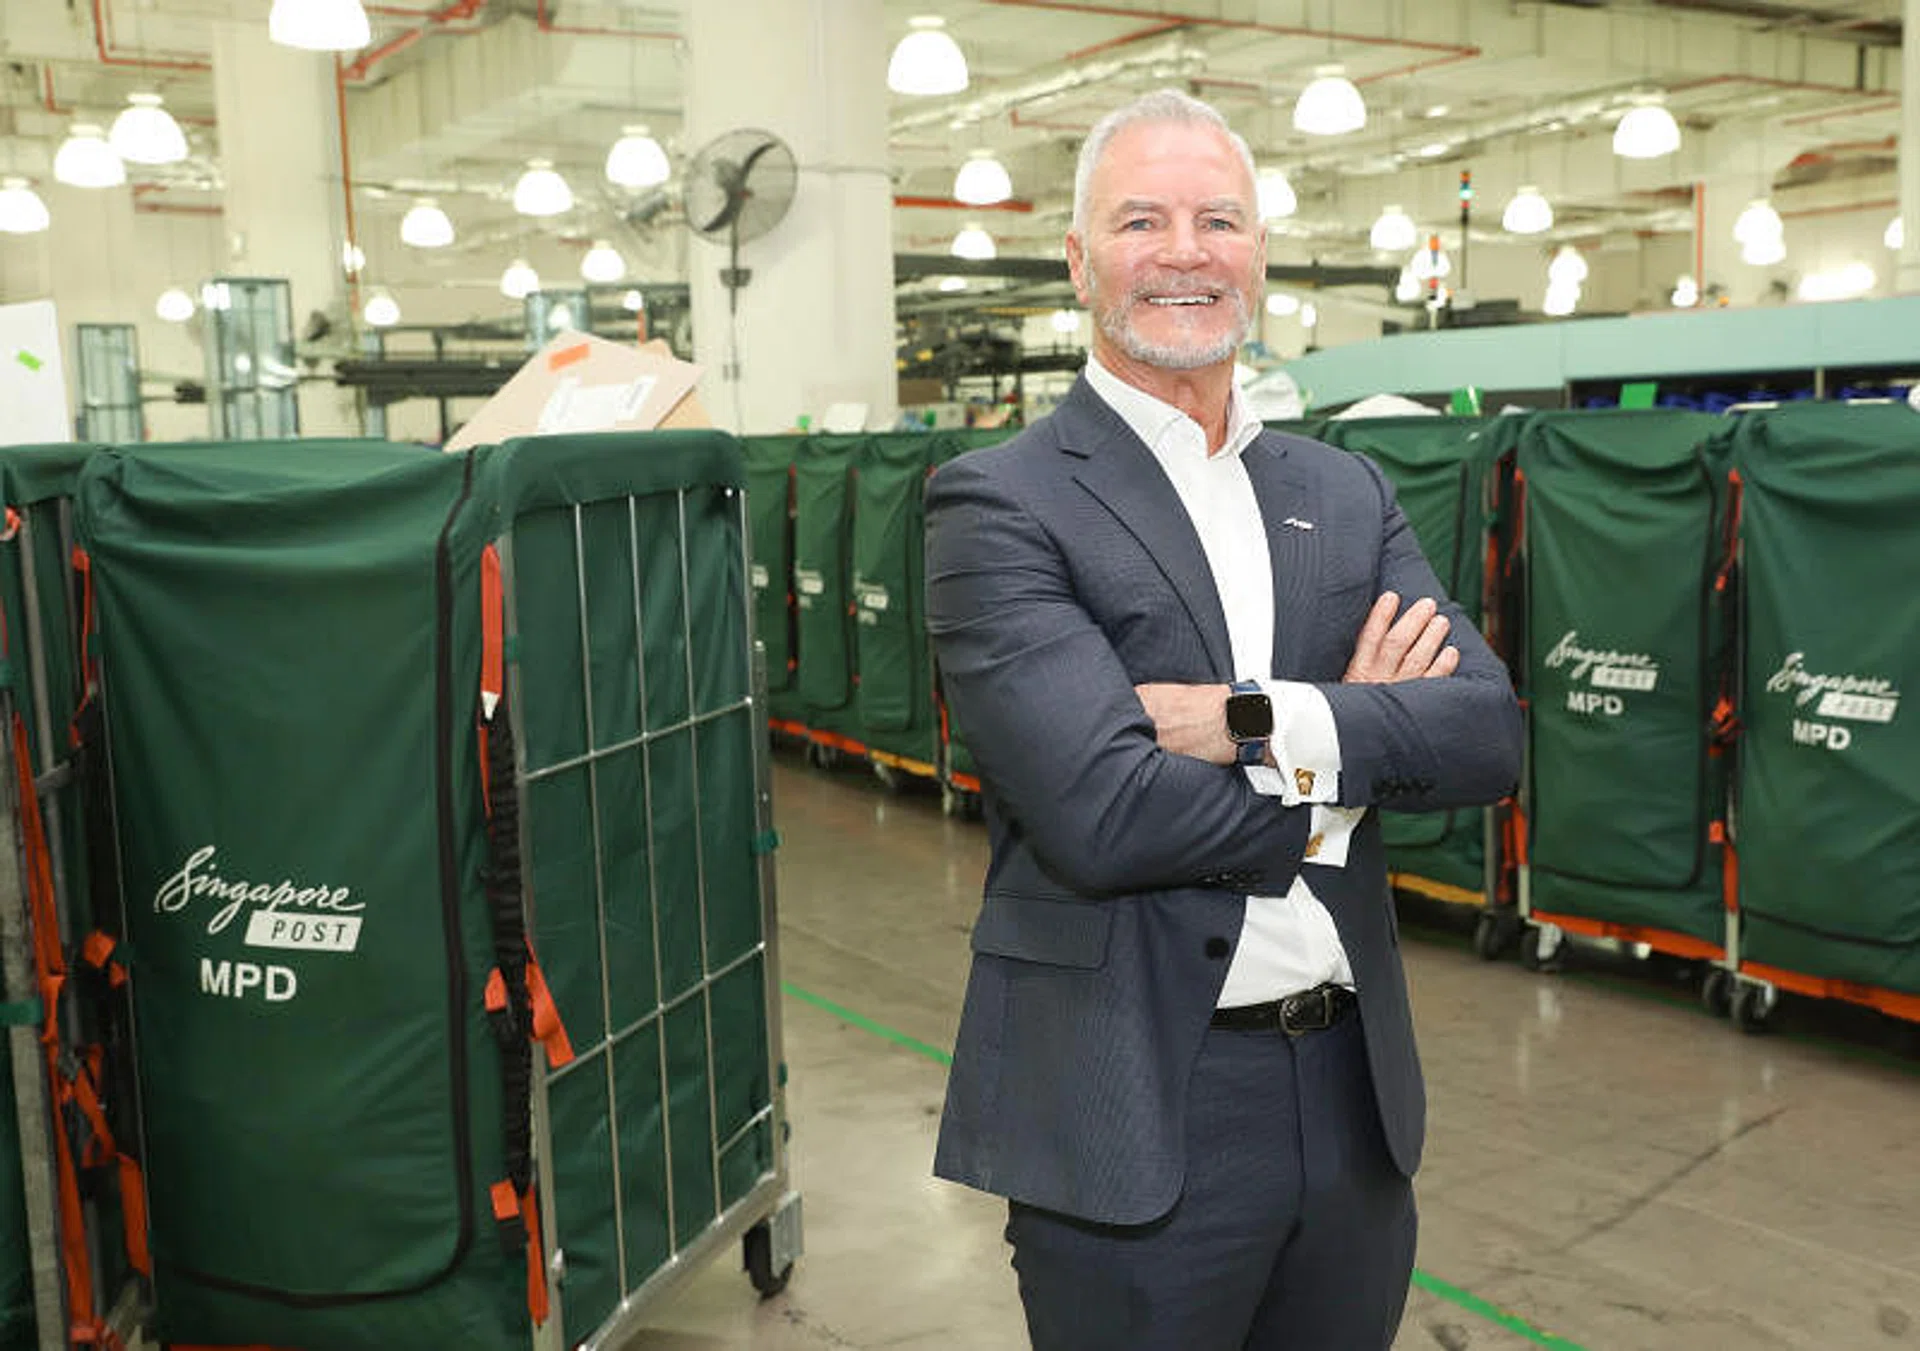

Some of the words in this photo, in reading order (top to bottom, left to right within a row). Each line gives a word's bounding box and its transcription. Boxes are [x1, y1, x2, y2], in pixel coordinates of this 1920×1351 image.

[1567, 691, 1623, 714] MPD
[1794, 719, 1851, 750] MPD
[154, 845, 366, 935] Singapore
[271, 919, 347, 943] POST
[201, 957, 297, 1001] MPD
